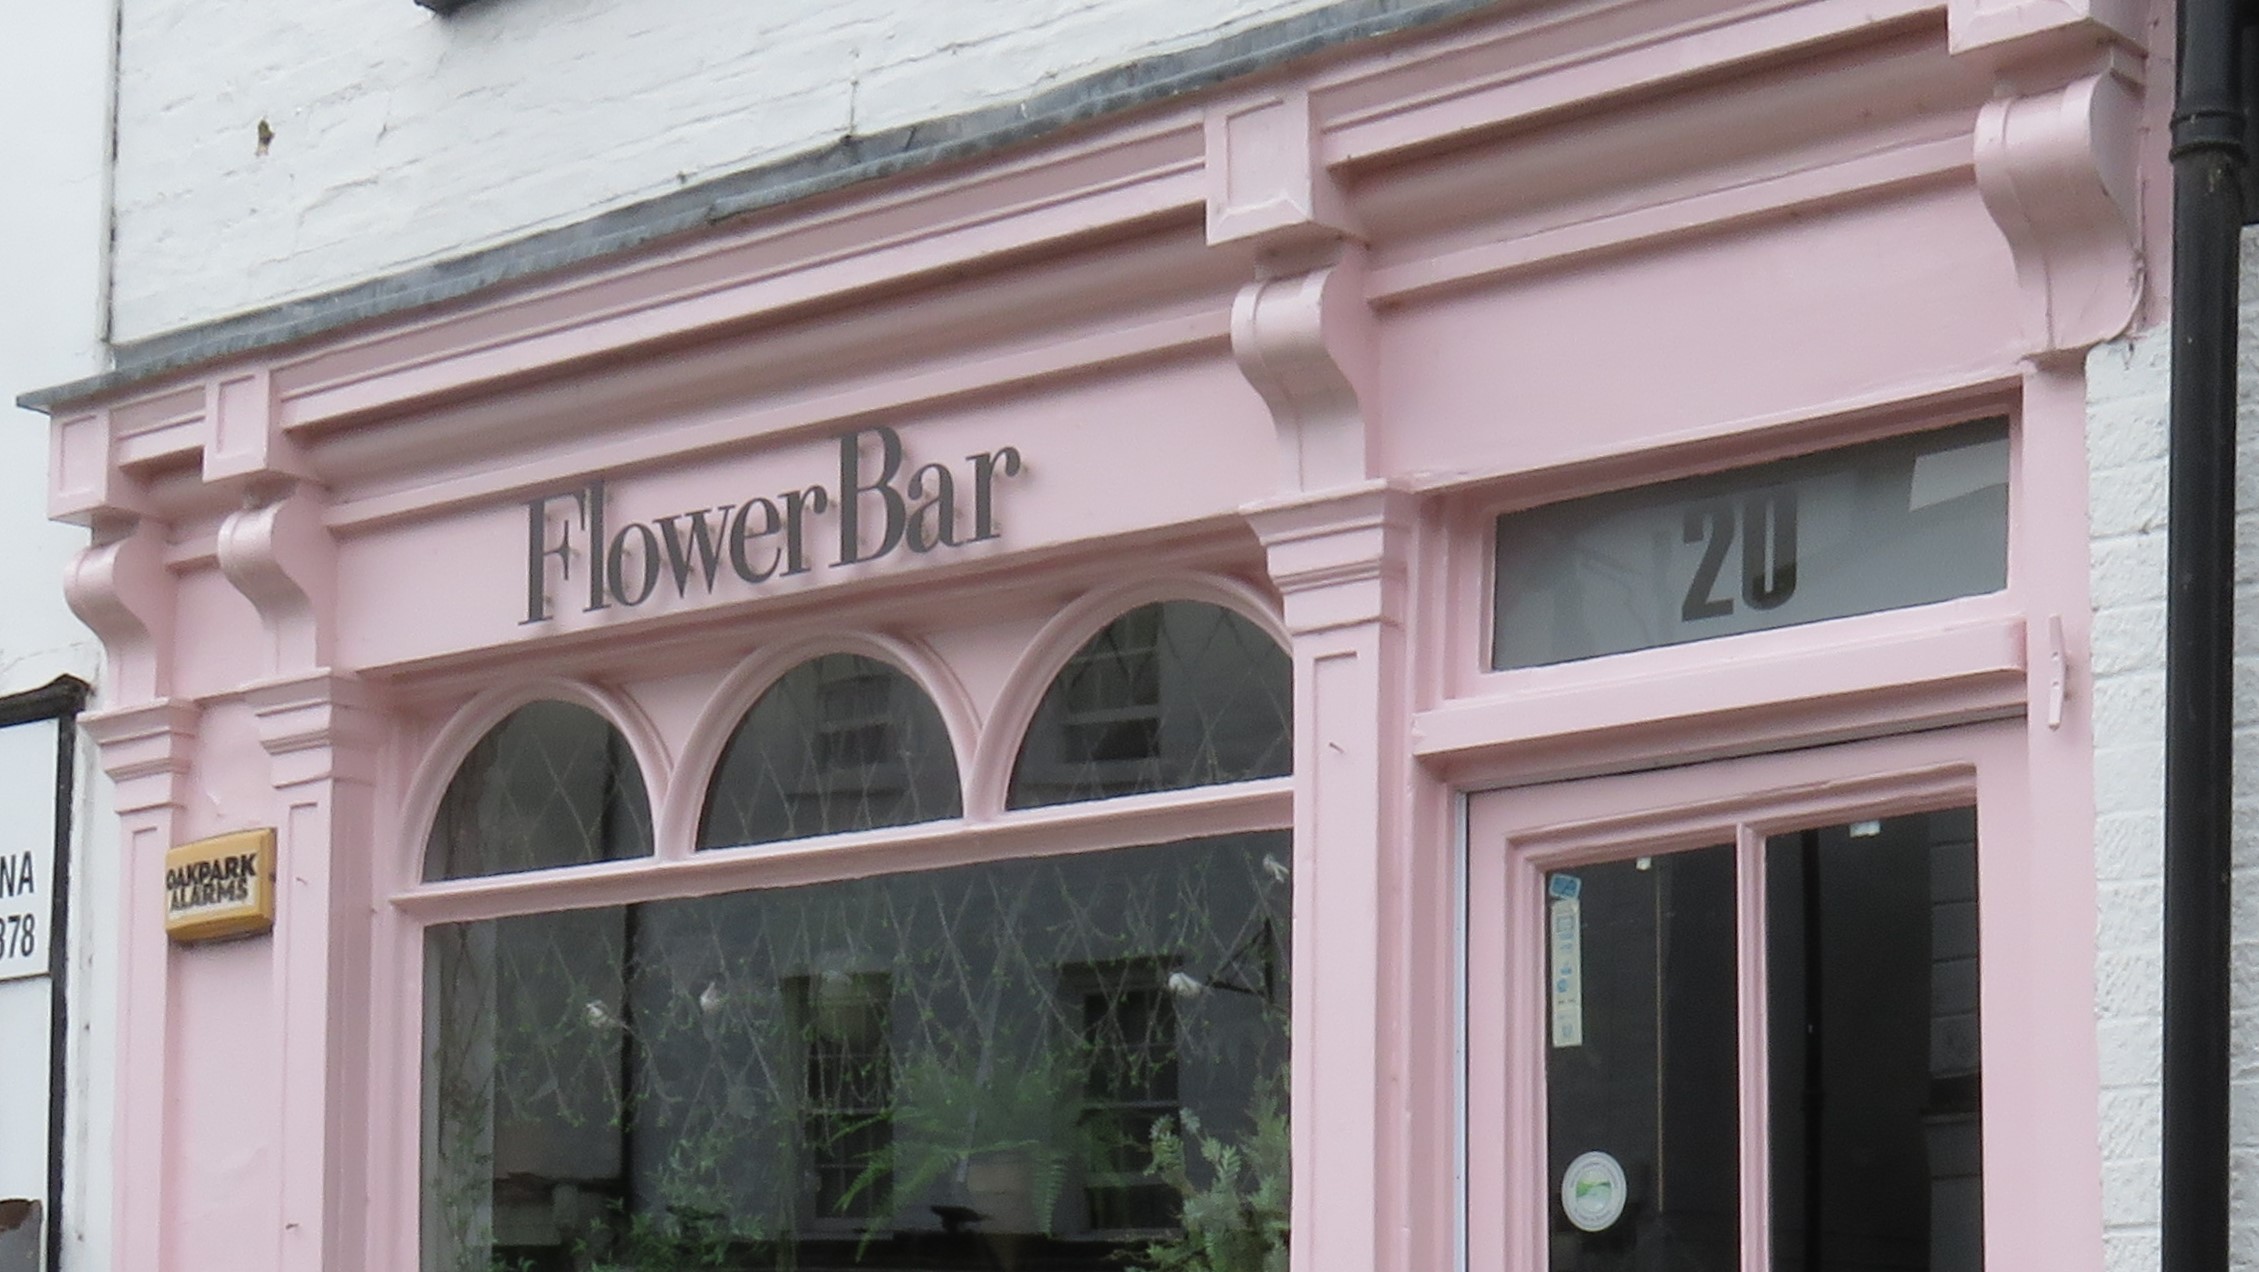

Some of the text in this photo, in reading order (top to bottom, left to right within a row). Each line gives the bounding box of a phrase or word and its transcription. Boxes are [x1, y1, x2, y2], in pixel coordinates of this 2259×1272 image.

[1681, 488, 1798, 622] 20
[166, 853, 257, 890] OAKPARK
[170, 877, 248, 911] ALARMS
